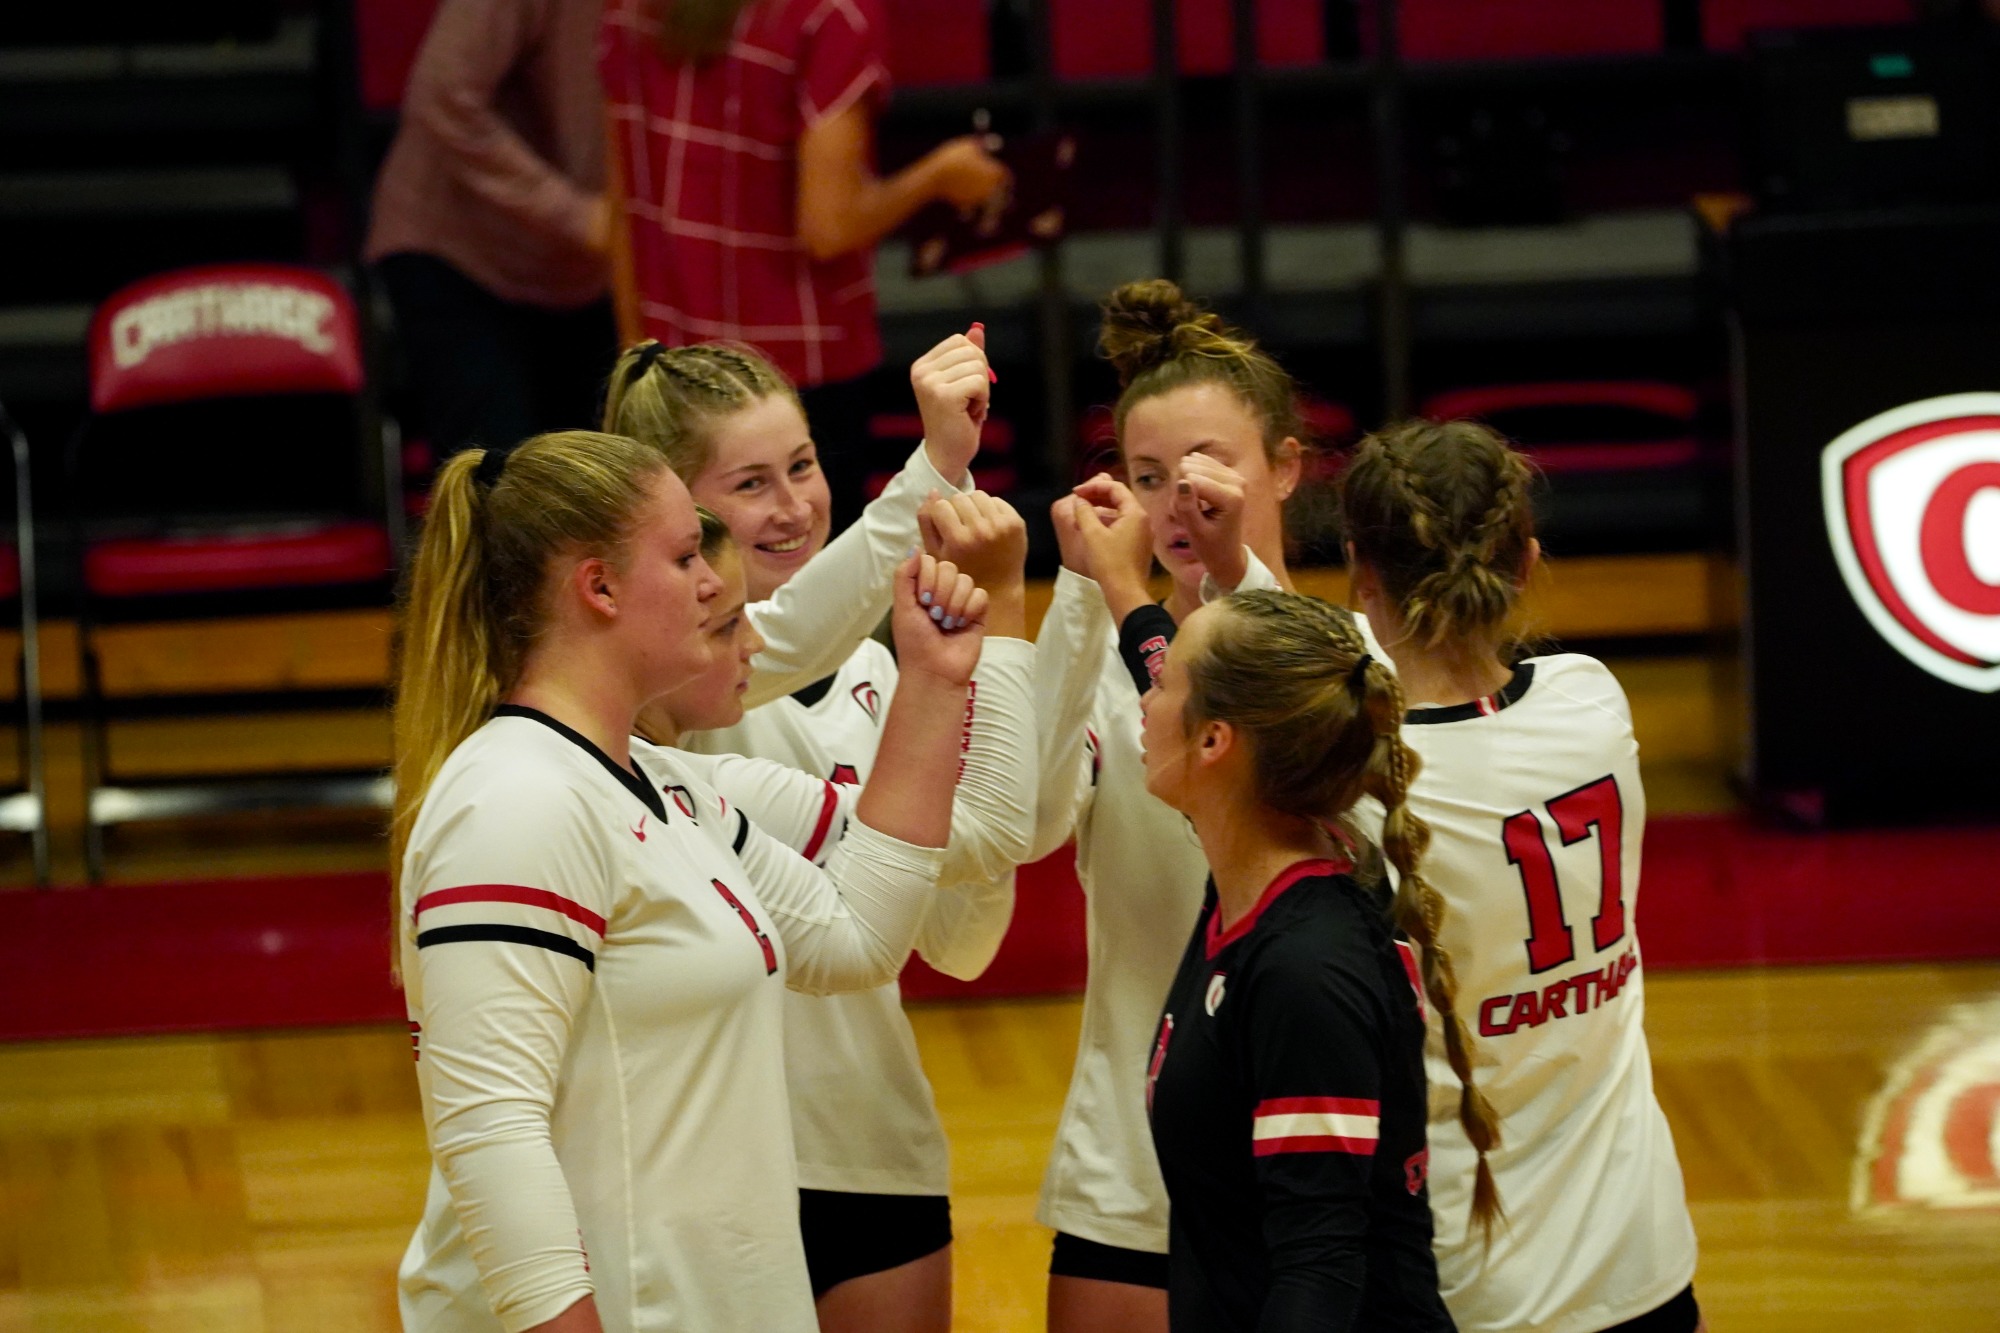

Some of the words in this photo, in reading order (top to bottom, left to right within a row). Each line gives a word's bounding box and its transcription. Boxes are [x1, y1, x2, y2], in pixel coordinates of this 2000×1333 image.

[110, 281, 337, 370] CARTHAGE
[1502, 773, 1625, 975] 17
[1478, 942, 1637, 1037] CARTHA
